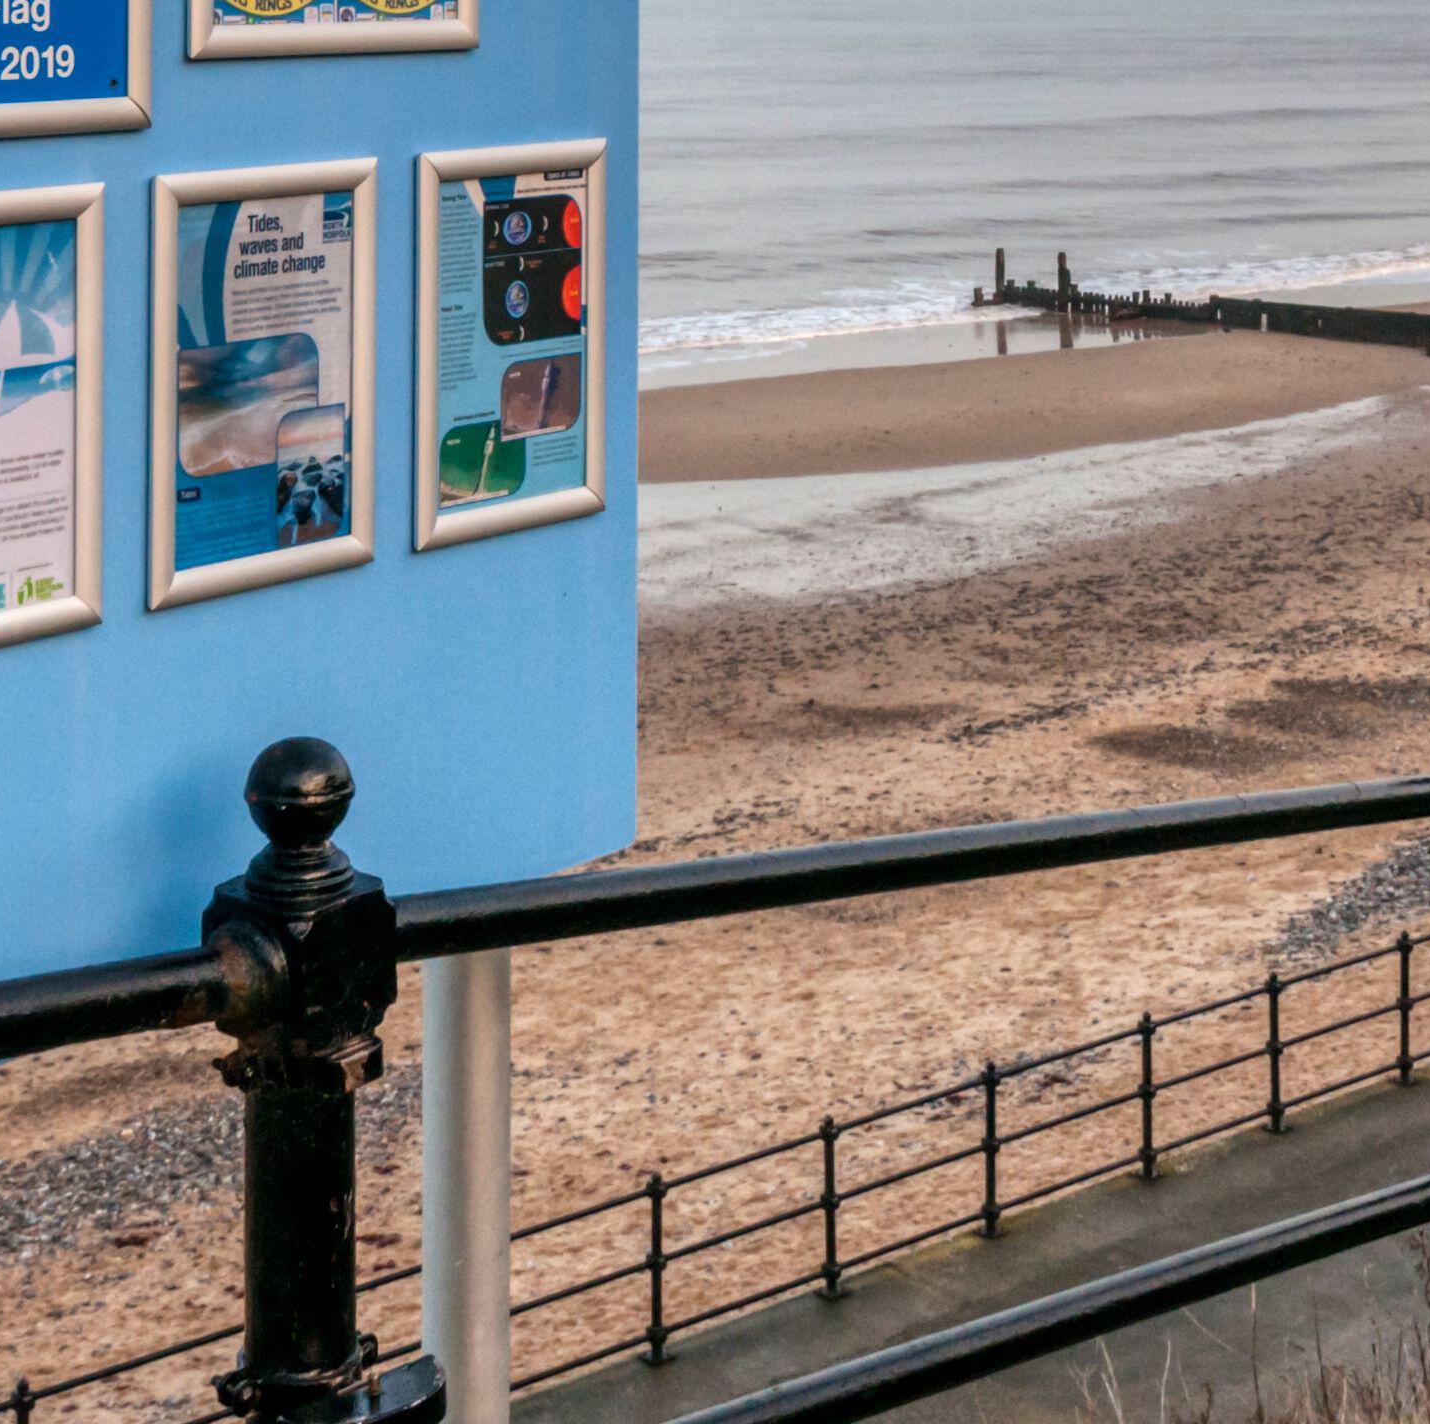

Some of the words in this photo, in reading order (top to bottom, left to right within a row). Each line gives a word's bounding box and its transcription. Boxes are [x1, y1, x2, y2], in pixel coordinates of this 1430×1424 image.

[0, 44, 75, 80] 2019
[247, 214, 283, 234] Tides,
[239, 239, 277, 257] waves
[281, 232, 304, 252] and
[233, 257, 278, 279] climate
[281, 254, 325, 274] change
